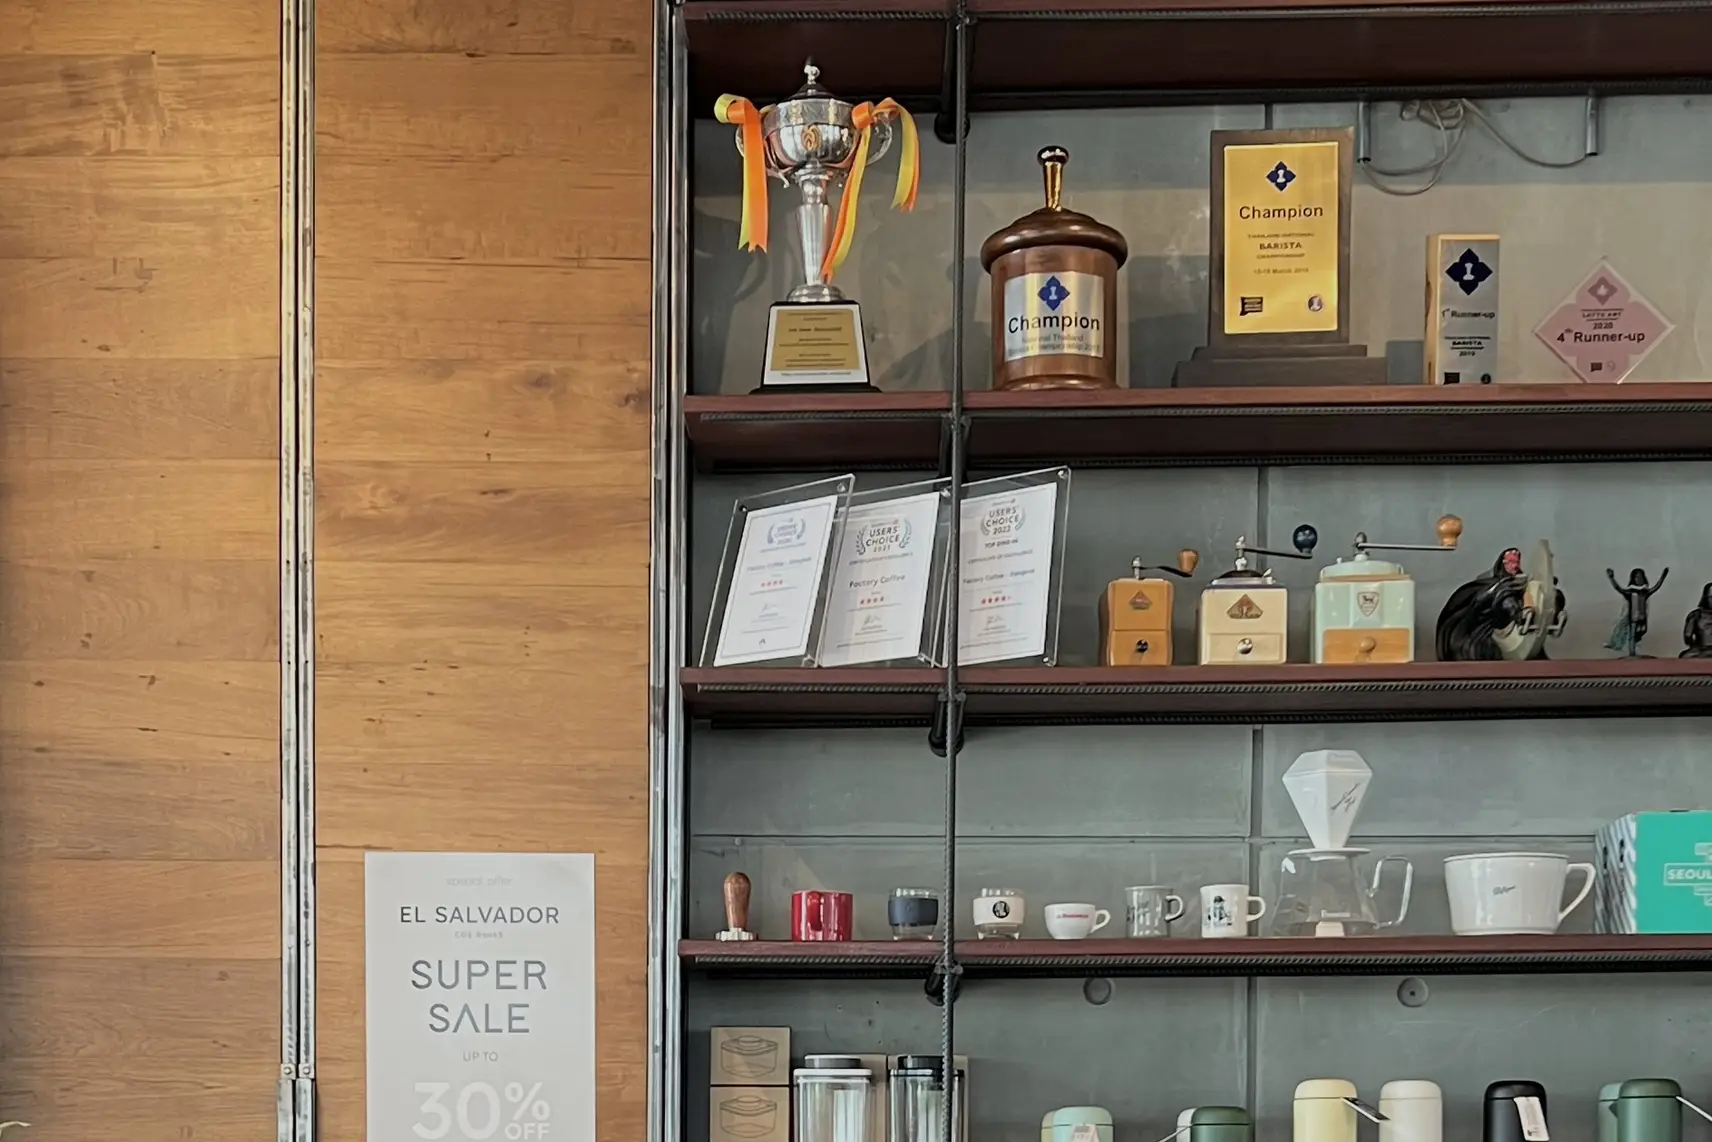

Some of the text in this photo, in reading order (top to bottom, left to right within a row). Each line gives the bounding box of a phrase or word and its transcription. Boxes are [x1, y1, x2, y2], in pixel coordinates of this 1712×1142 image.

[1239, 205, 1323, 221] Champion
[1259, 242, 1302, 250] BARISTA
[1008, 312, 1100, 334] Champion
[1573, 331, 1645, 344] Runner-up
[865, 534, 900, 547] CHOICE
[400, 906, 559, 924] EL SALVADOR
[411, 959, 547, 990] SUPER
[428, 1003, 530, 1033] SALE
[462, 1052, 499, 1062] UP TO
[412, 1081, 551, 1140] 30%
[504, 1122, 551, 1140] OFF
